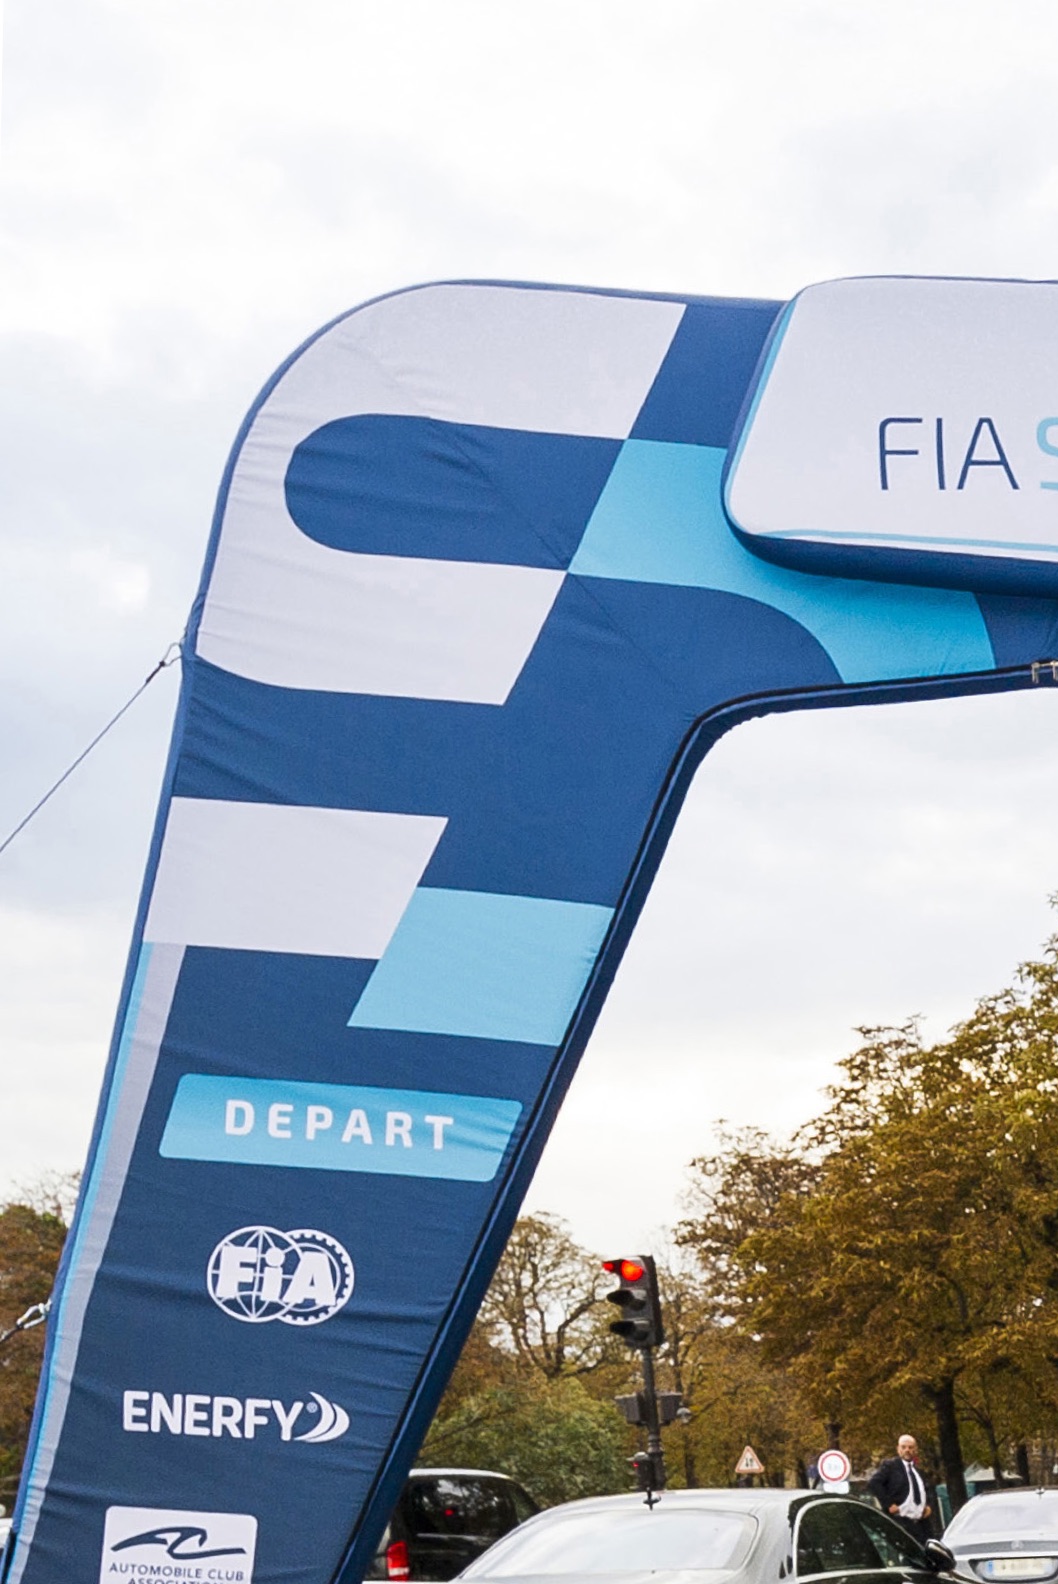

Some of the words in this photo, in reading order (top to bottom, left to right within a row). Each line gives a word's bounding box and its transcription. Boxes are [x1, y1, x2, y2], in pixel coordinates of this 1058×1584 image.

[878, 416, 1020, 491] FIA
[224, 1098, 454, 1151] DEPART
[109, 1562, 203, 1579] AUTOMOBILE
[207, 1568, 244, 1582] CLUB
